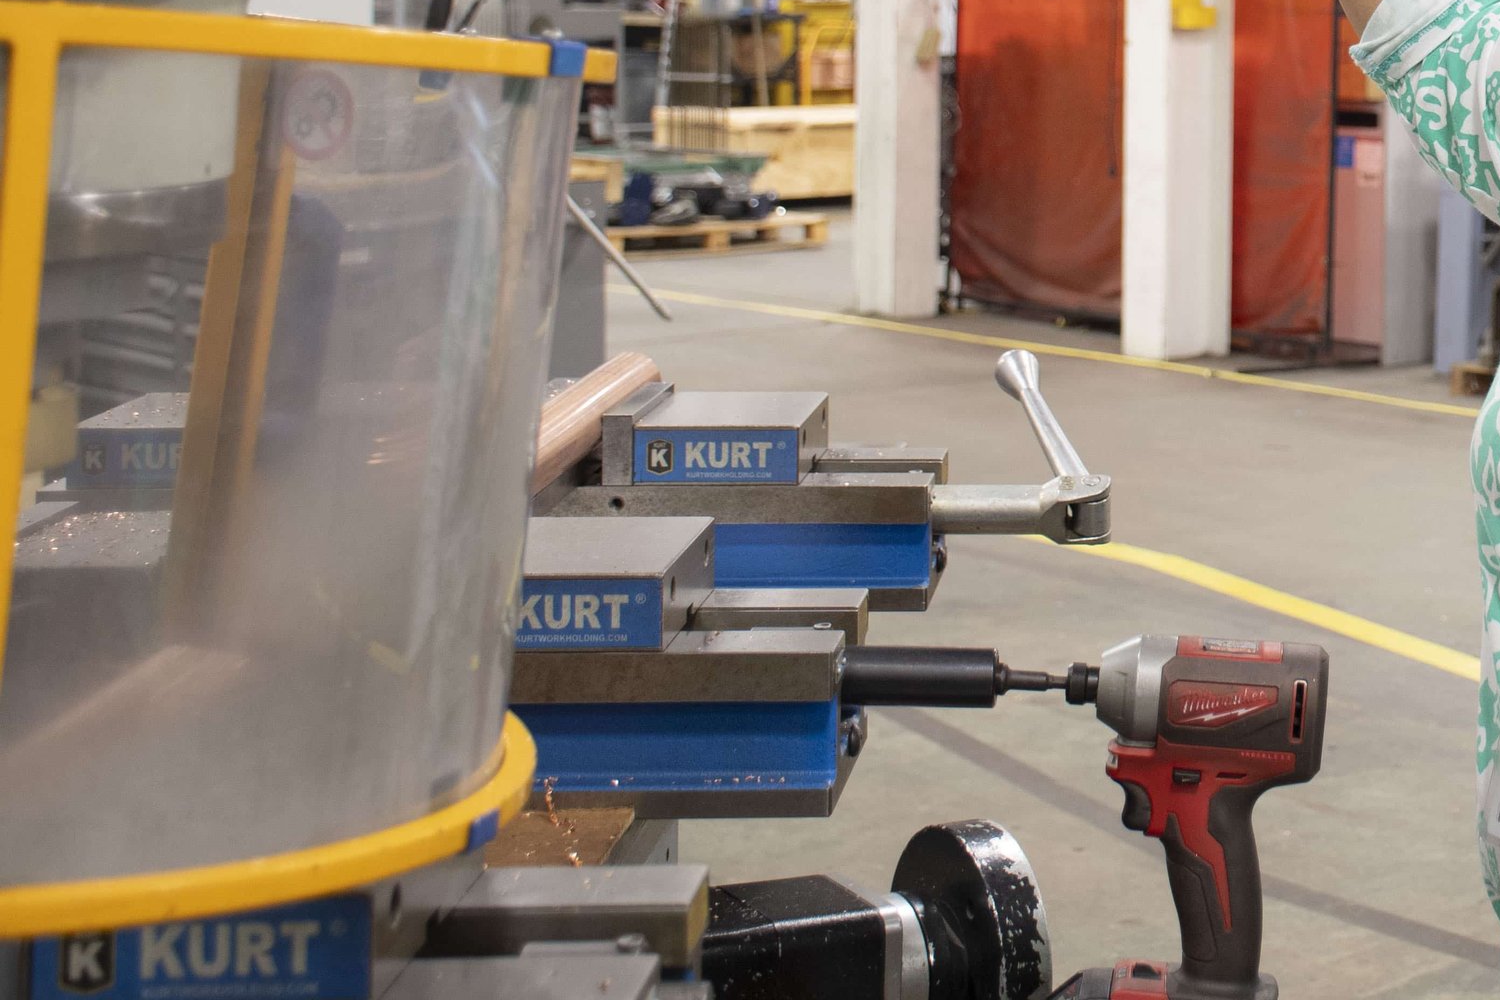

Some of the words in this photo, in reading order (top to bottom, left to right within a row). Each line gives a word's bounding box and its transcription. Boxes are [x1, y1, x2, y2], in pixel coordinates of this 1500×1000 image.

[121, 442, 178, 470] KU
[651, 449, 669, 468] K
[685, 442, 773, 469] KURT
[686, 471, 773, 479] KURTWORKHOLDING.COM
[518, 594, 630, 630] KURT
[515, 633, 629, 644] KURTWORKHOLDING.COM
[66, 941, 105, 982] K
[139, 919, 321, 980] KURT
